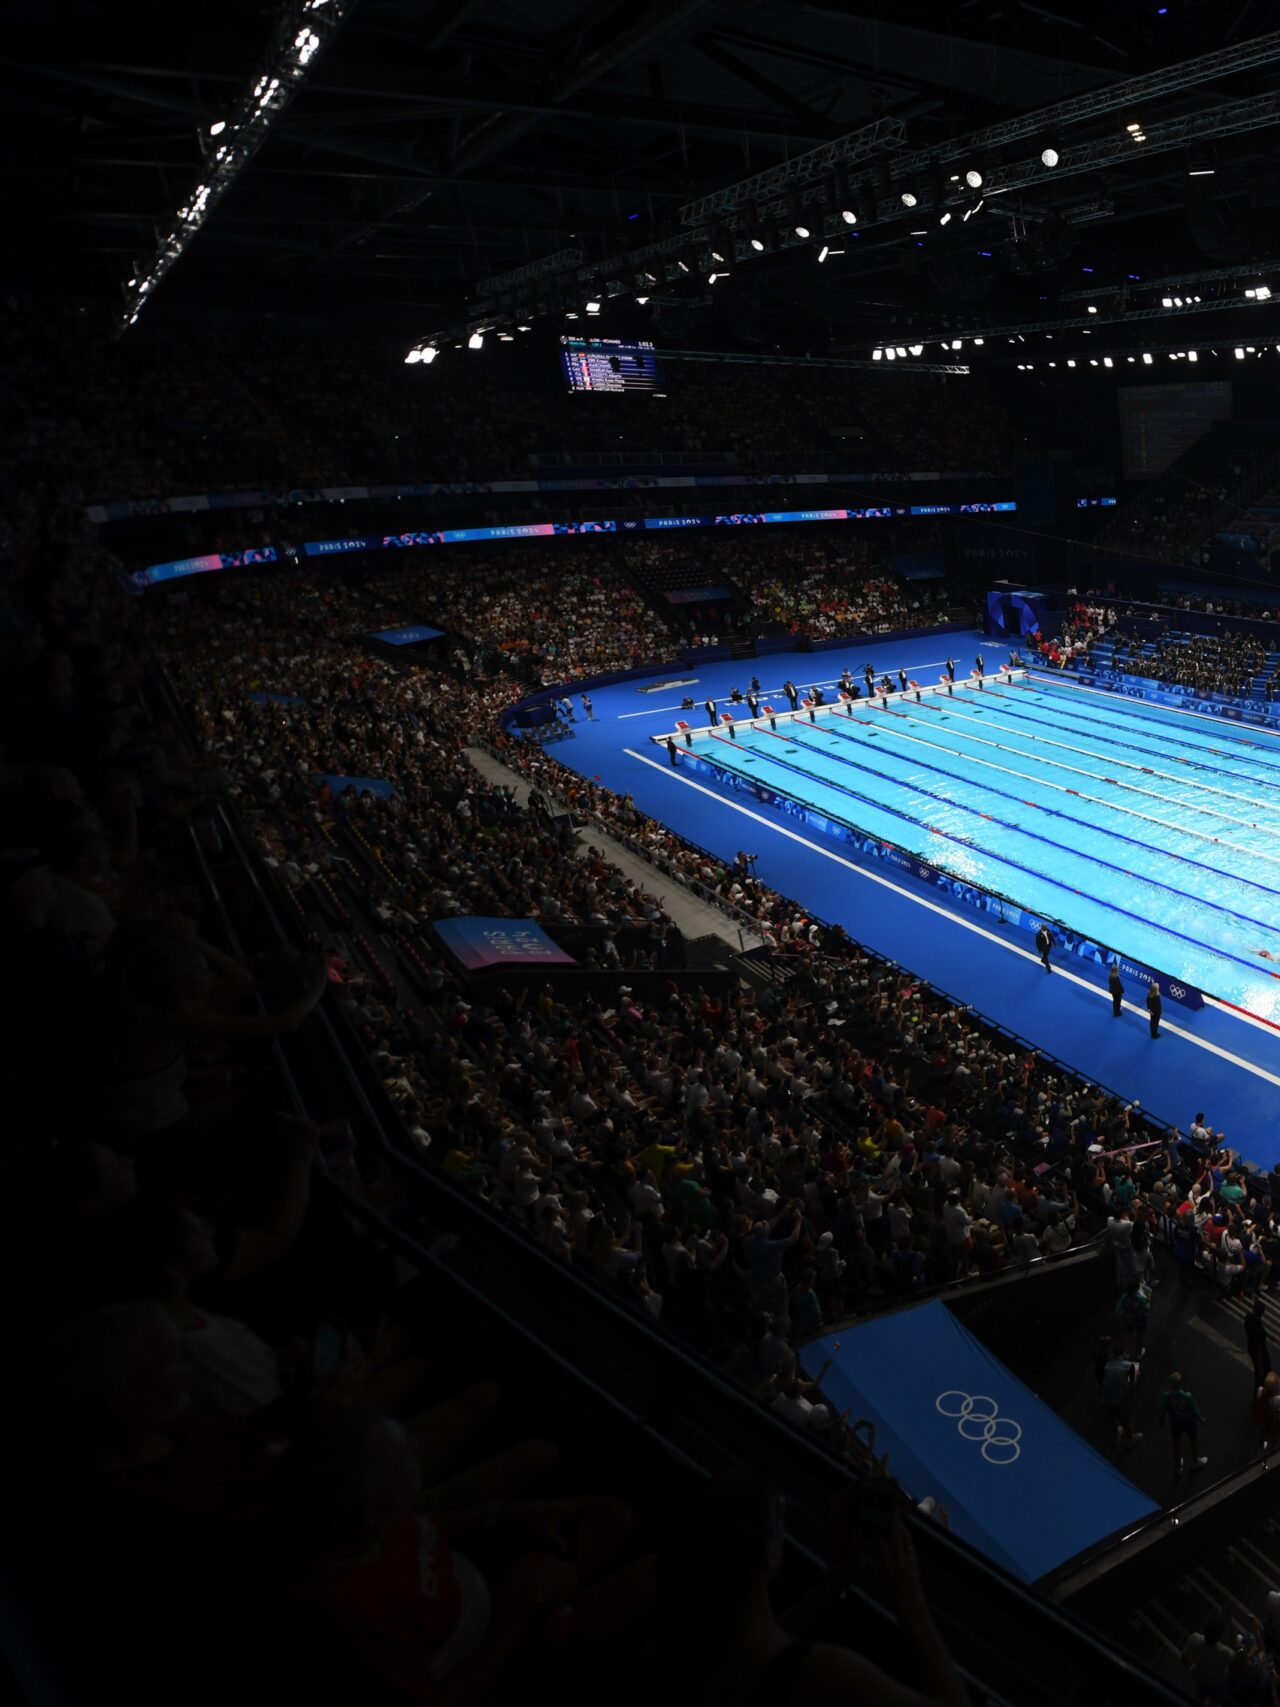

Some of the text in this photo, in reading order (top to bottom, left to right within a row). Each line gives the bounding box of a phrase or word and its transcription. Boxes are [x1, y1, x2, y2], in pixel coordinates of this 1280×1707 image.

[681, 518, 701, 526] 2024
[490, 527, 539, 536] PARIS 2024
[319, 541, 366, 552] PARIS 2024
[1121, 963, 1155, 984] PARIS 2024
